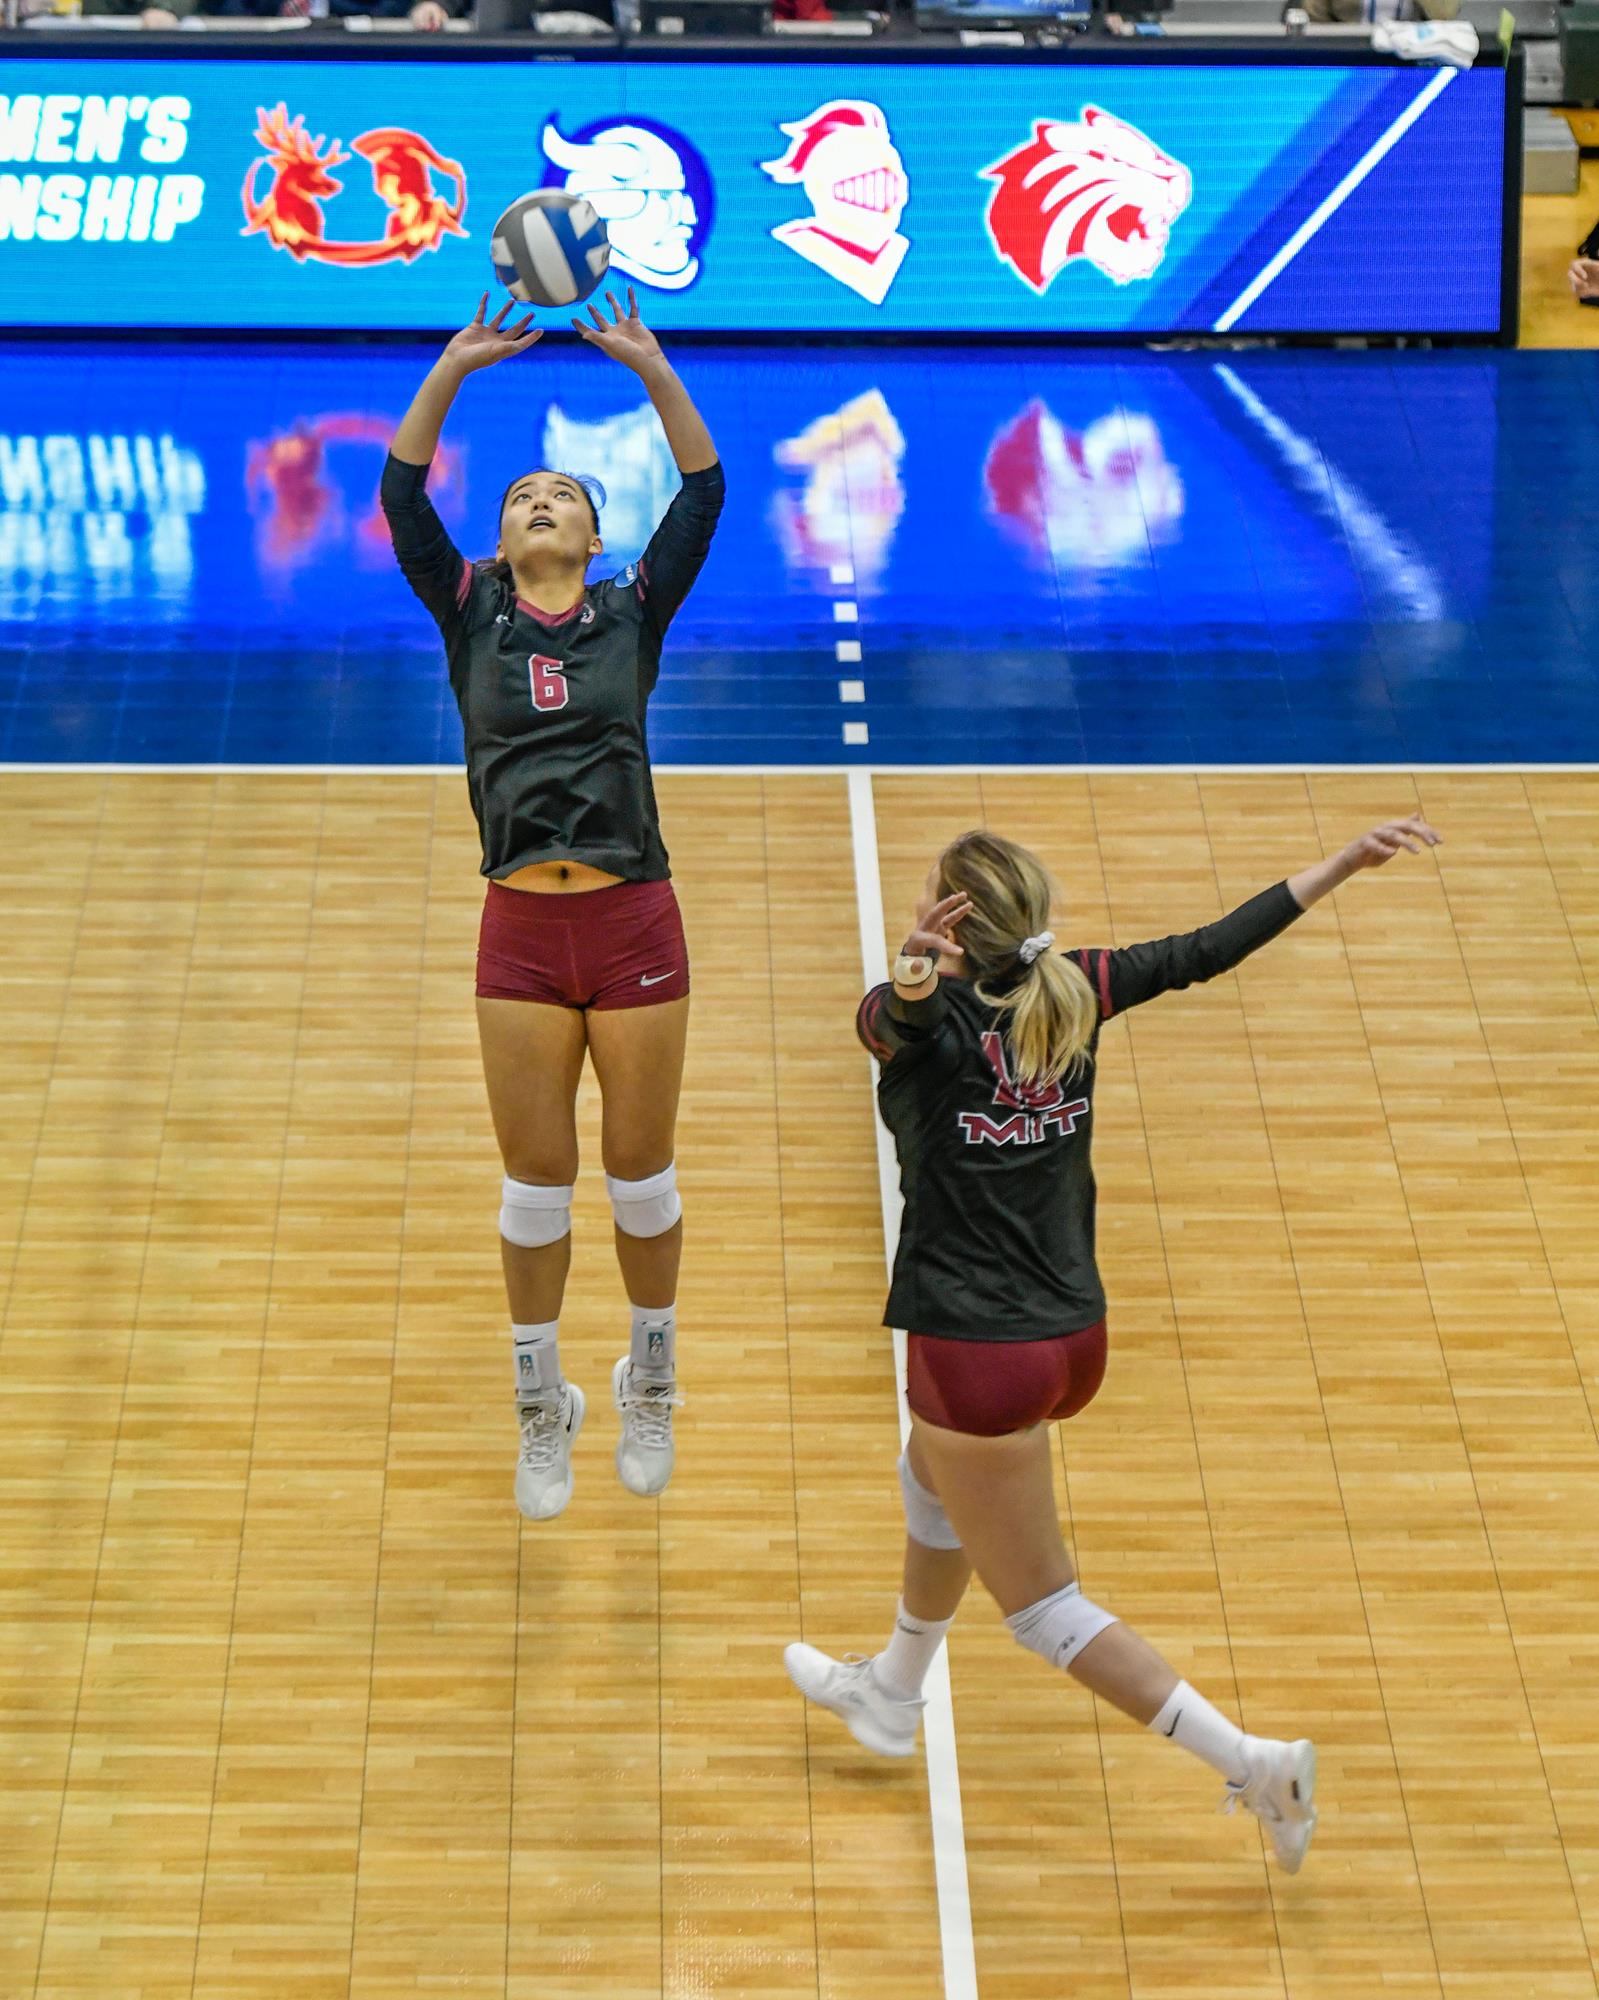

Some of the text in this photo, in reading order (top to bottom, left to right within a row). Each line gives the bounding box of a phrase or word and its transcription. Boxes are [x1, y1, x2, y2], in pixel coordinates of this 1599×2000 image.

[0, 174, 205, 242] NSHIP
[528, 653, 569, 712] 6
[957, 1097, 1090, 1147] MIT
